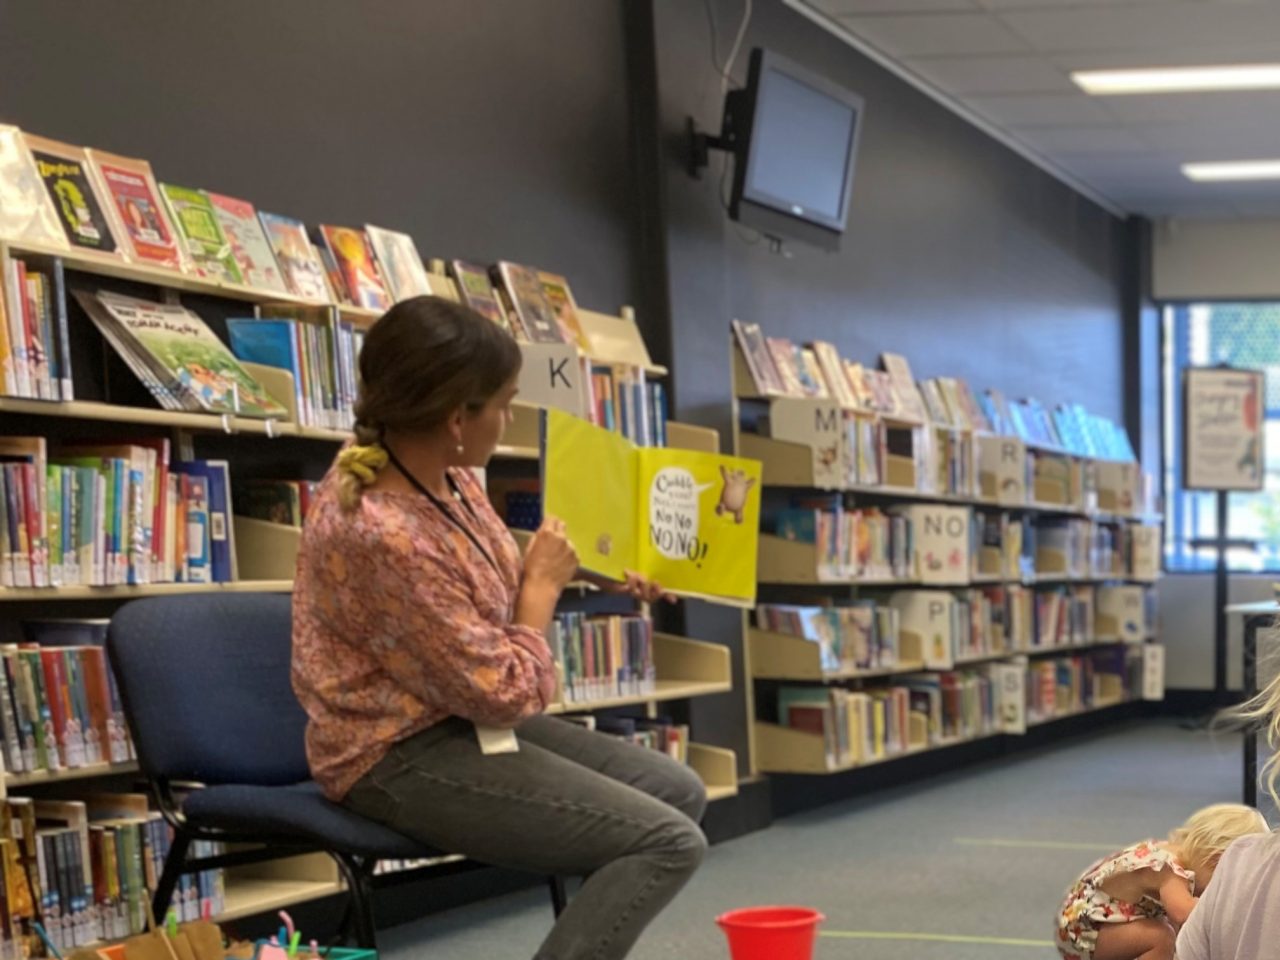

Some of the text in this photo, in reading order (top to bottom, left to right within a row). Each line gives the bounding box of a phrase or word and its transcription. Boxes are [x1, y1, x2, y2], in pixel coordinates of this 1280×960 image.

[549, 357, 572, 389] K
[814, 408, 838, 432] M
[1001, 442, 1018, 463] R
[929, 600, 945, 622] P
